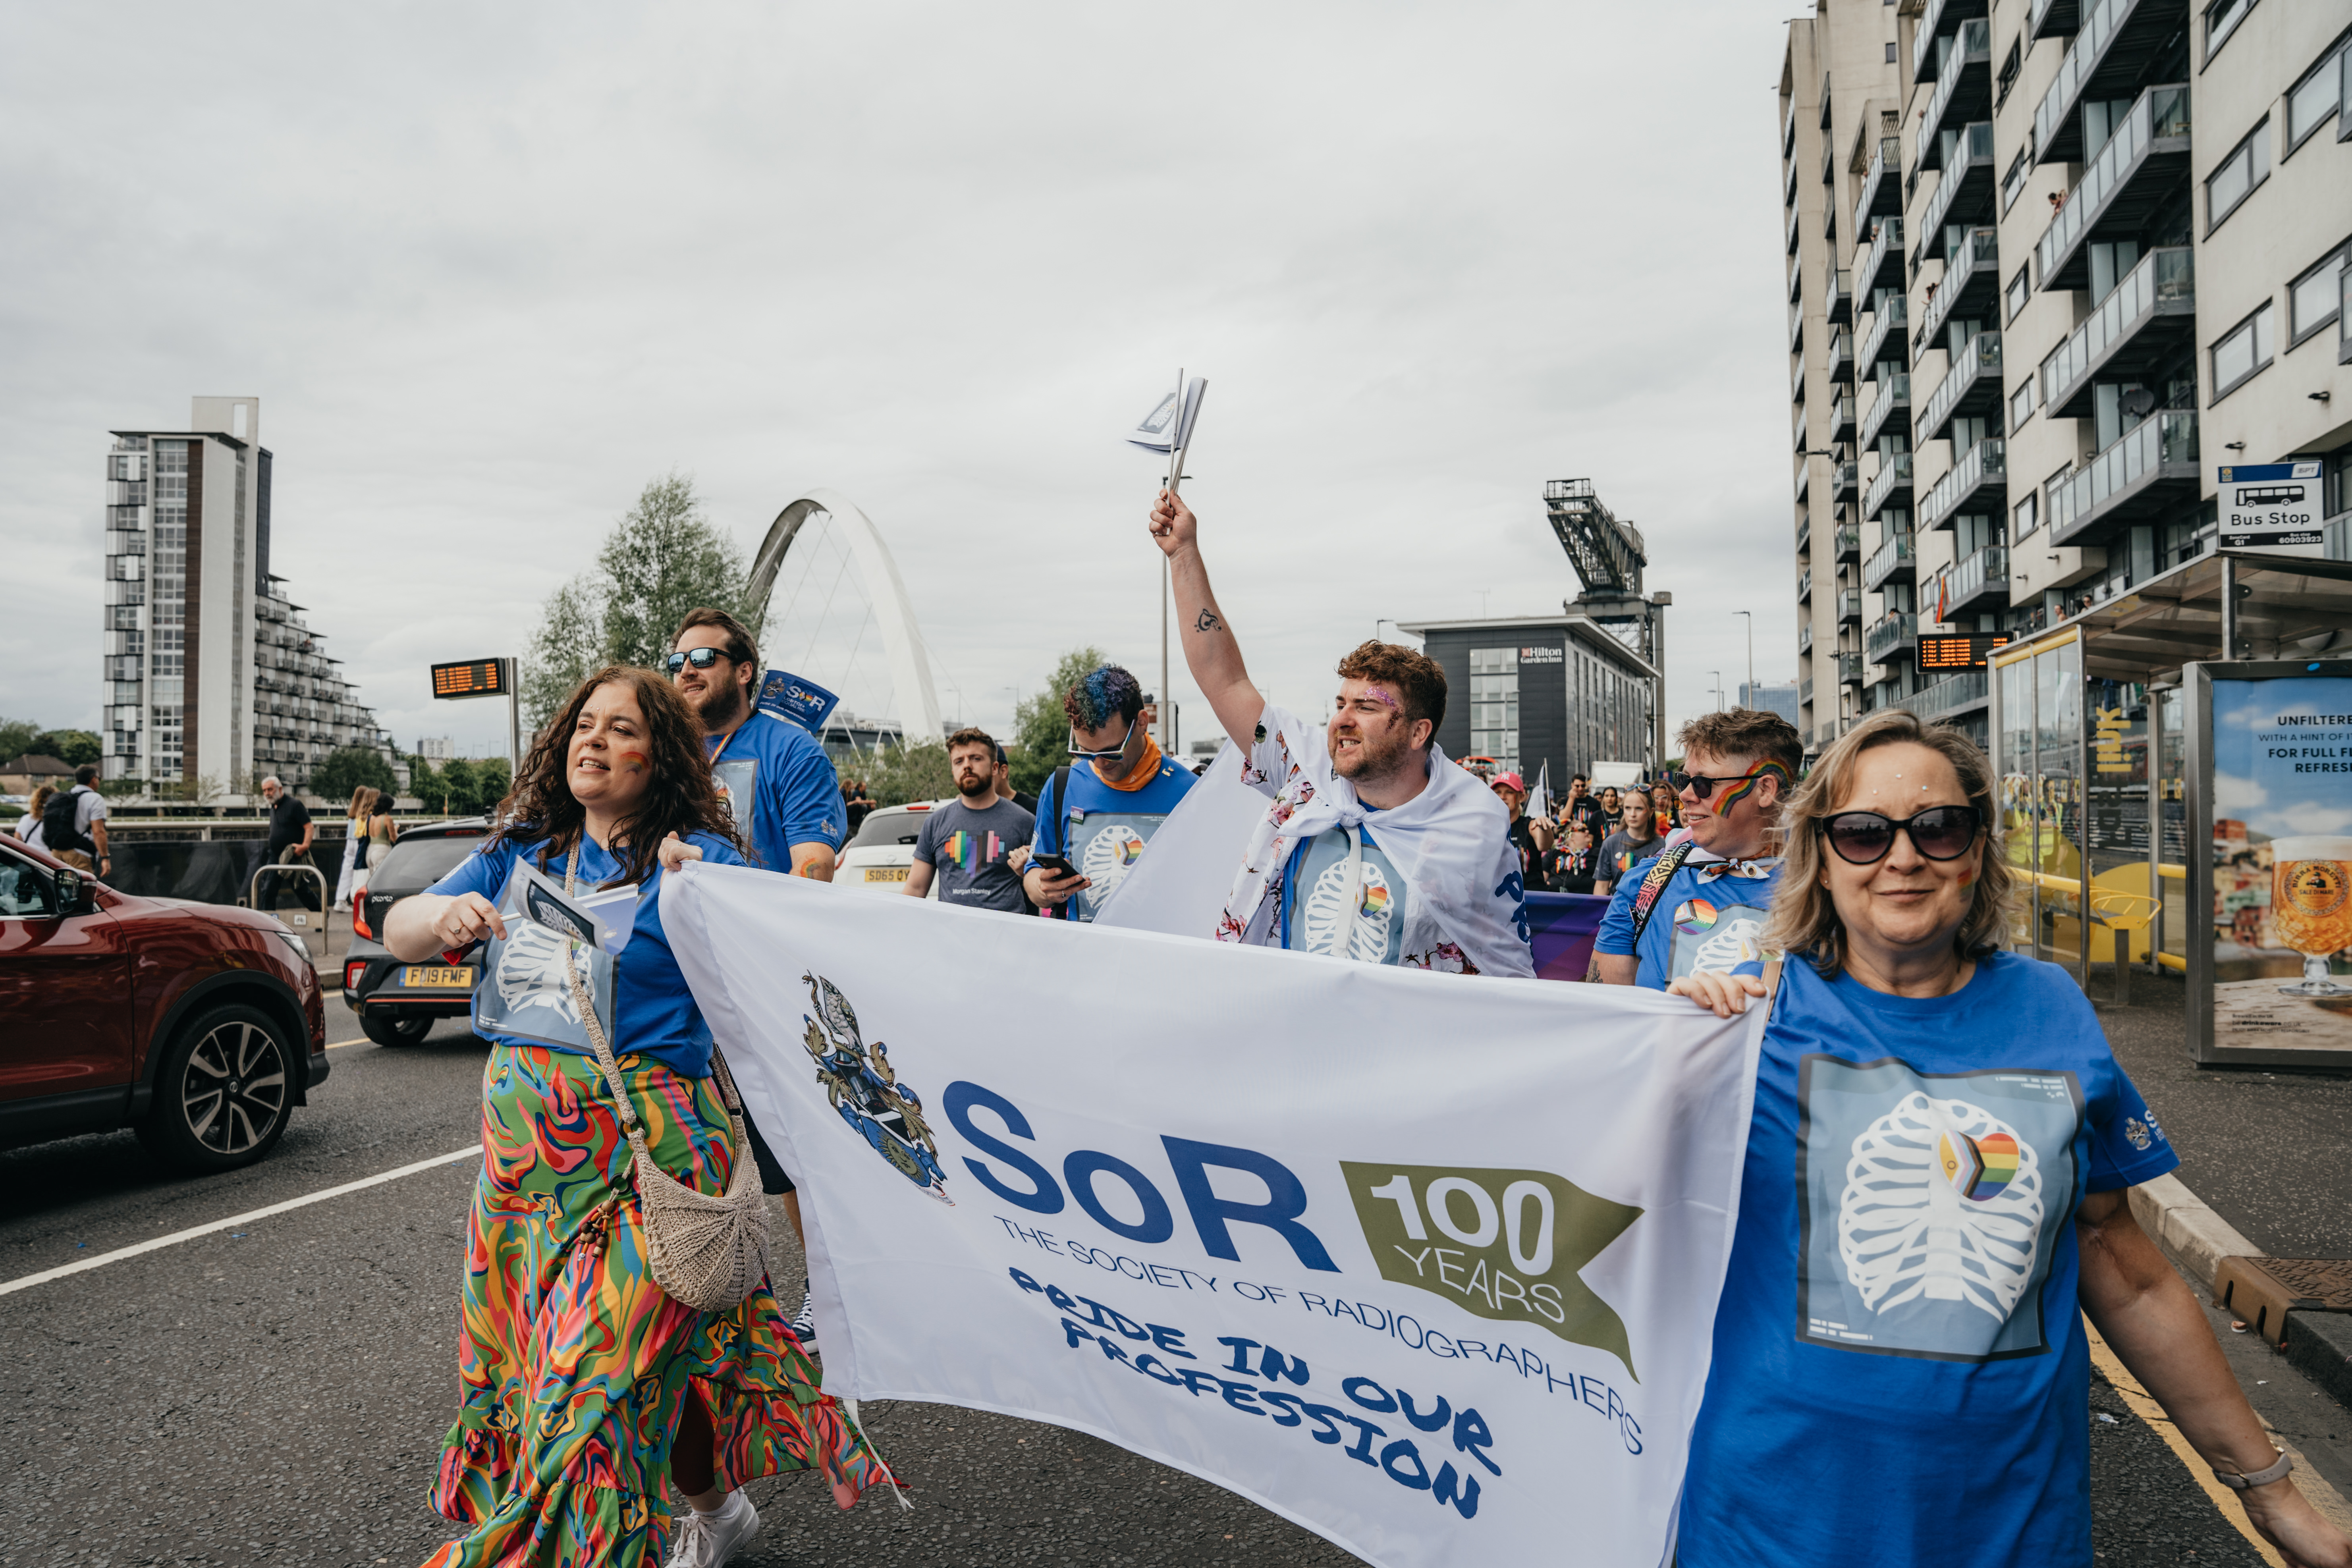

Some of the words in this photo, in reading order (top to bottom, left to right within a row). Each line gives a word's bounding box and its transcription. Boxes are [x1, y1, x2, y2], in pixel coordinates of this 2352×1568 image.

[2231, 514, 2262, 526] Bus
[2269, 512, 2310, 525] Stop
[2279, 536, 2322, 544] 60903923
[1530, 647, 1562, 657] Hilton
[2269, 748, 2297, 758] FOR
[2302, 748, 2337, 757] FULL
[869, 871, 894, 880] SD65
[897, 870, 909, 880] OY
[2292, 867, 2311, 888] BIRRA
[2313, 866, 2341, 888] MORETTI
[371, 895, 393, 904] picanto
[442, 969, 467, 983] FMF
[943, 1080, 1343, 1273] SoR
[1370, 1175, 1554, 1276] 100
[1393, 1245, 1565, 1323] YEARS
[993, 1215, 1064, 1256] THE
[1067, 1240, 1218, 1292] SOCIETY
[1233, 1281, 1287, 1304] OF
[1298, 1291, 1643, 1455] RADIOGRAPHERS
[1009, 1267, 1197, 1360] PRIDE
[1217, 1336, 1310, 1386] IN
[1341, 1376, 1502, 1477] OUR
[1061, 1317, 1480, 1520] PROFESSION
